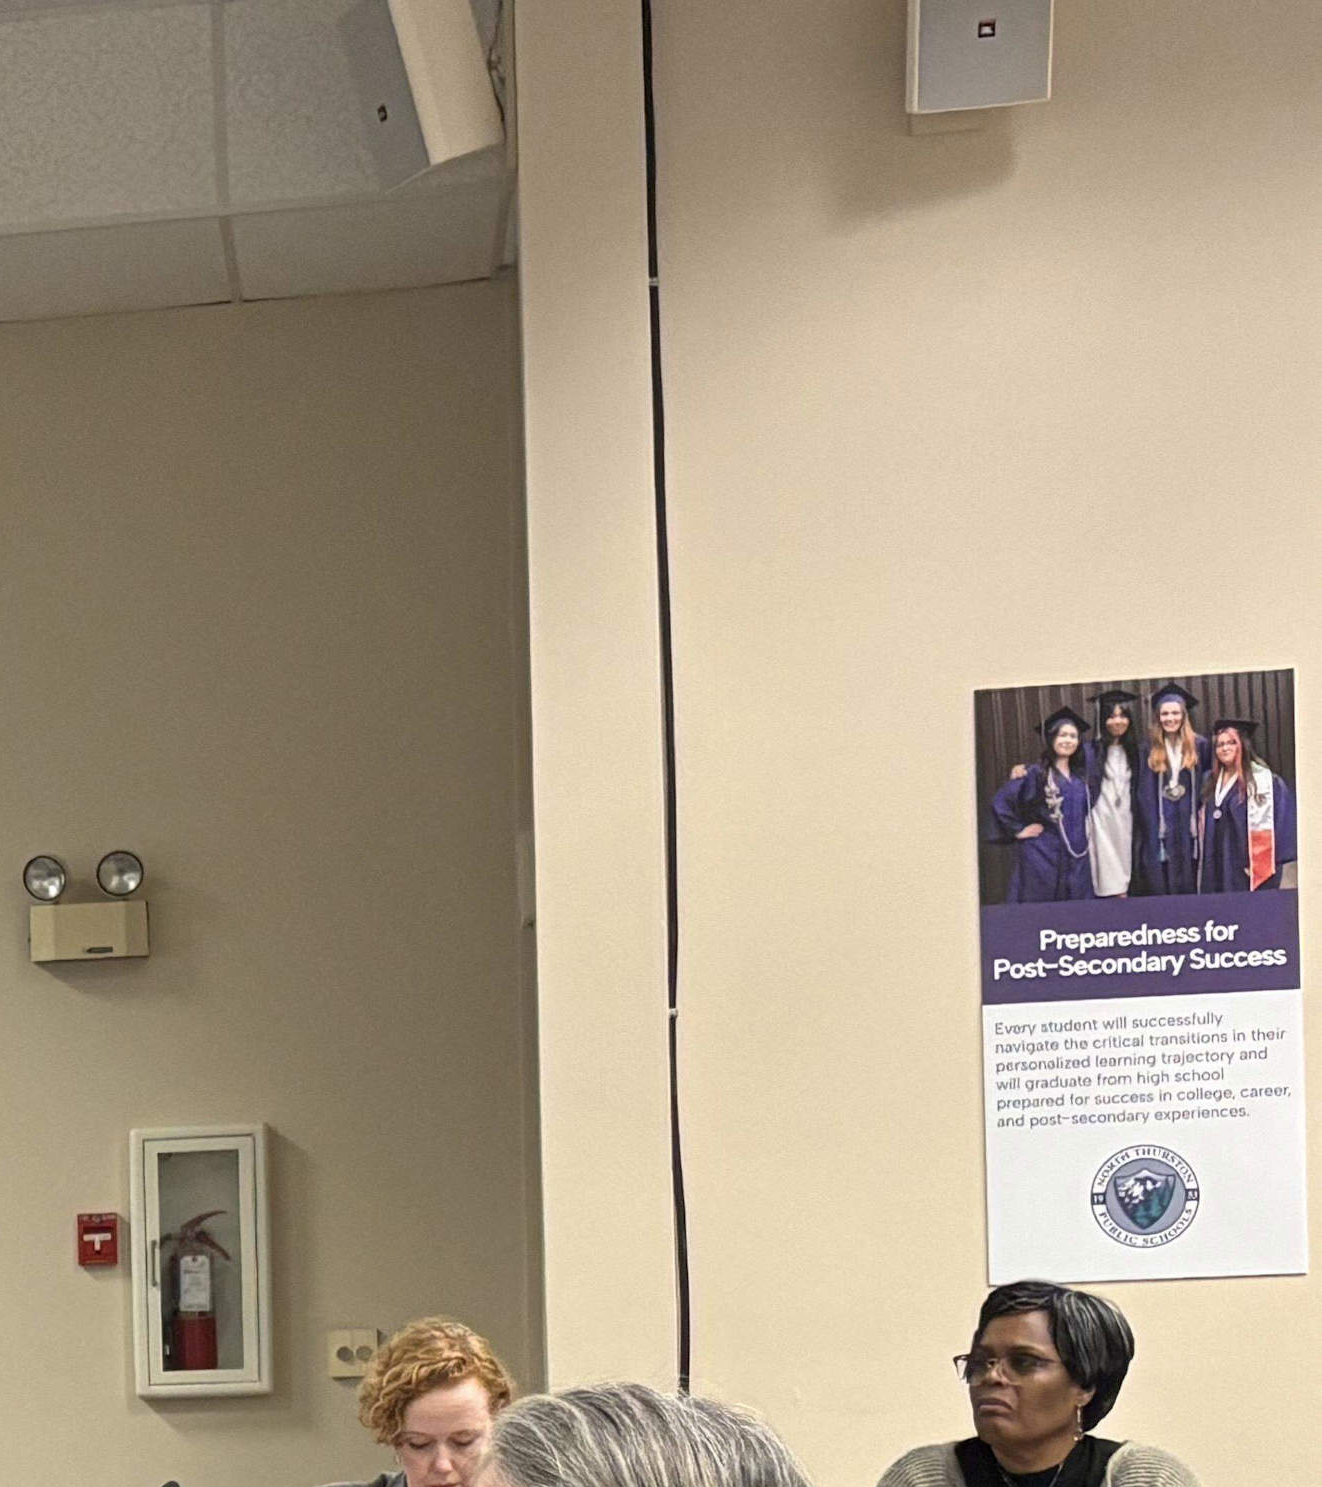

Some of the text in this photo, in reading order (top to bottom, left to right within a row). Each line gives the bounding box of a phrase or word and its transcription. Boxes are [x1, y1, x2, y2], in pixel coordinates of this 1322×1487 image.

[1040, 920, 1238, 953] Preparedness for
[1189, 948, 1287, 970] Success
[995, 1013, 1223, 1036] Every student will successfully
[995, 1028, 1286, 1056] navigate the critical transitions in their
[995, 1047, 1267, 1074] personalized learning trajectory and
[996, 1068, 1224, 1092] will graduate from high school
[997, 1086, 1291, 1111] prepared for success in college, career,
[997, 1114, 1025, 1128] and
[1154, 1106, 1250, 1122] experiences.
